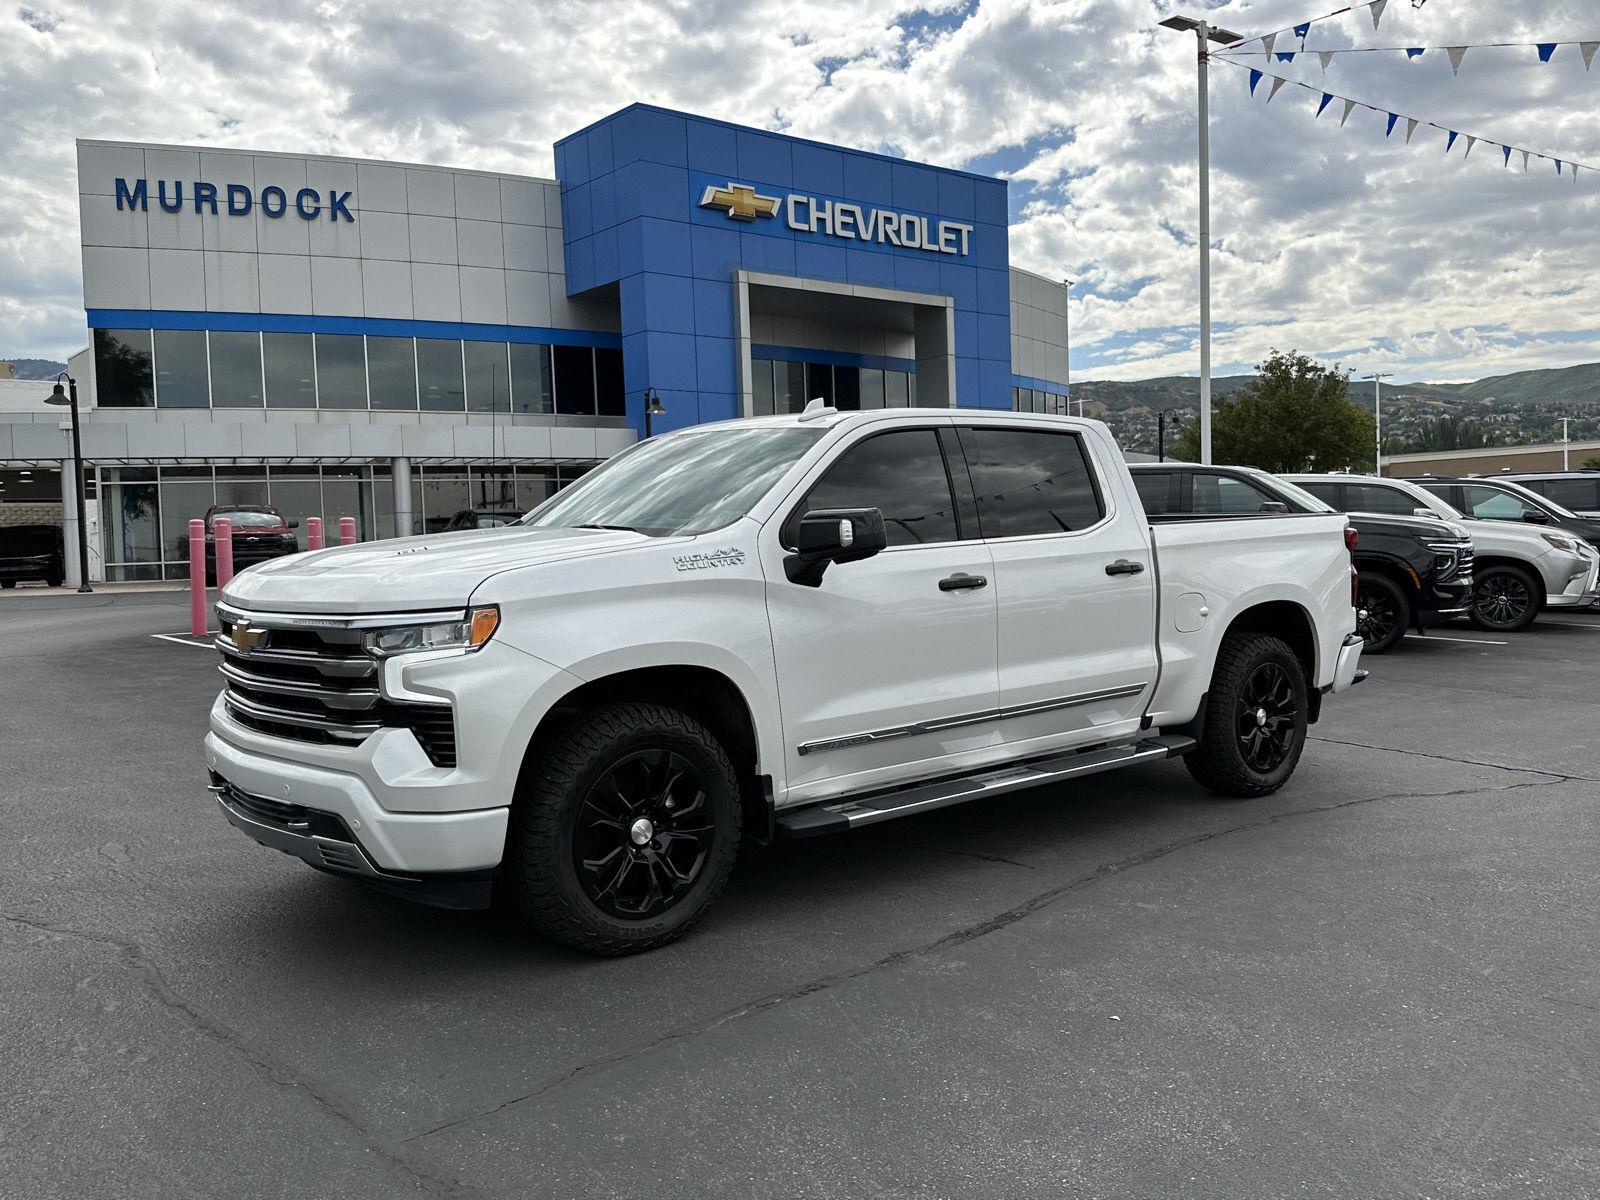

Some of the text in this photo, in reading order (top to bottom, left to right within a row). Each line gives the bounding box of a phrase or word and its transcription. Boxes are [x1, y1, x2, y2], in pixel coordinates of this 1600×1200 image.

[115, 178, 355, 223] MURDOCK
[786, 193, 974, 256] CHEVROLET
[672, 552, 711, 565] HIGH
[676, 557, 745, 572] COUNTRY
